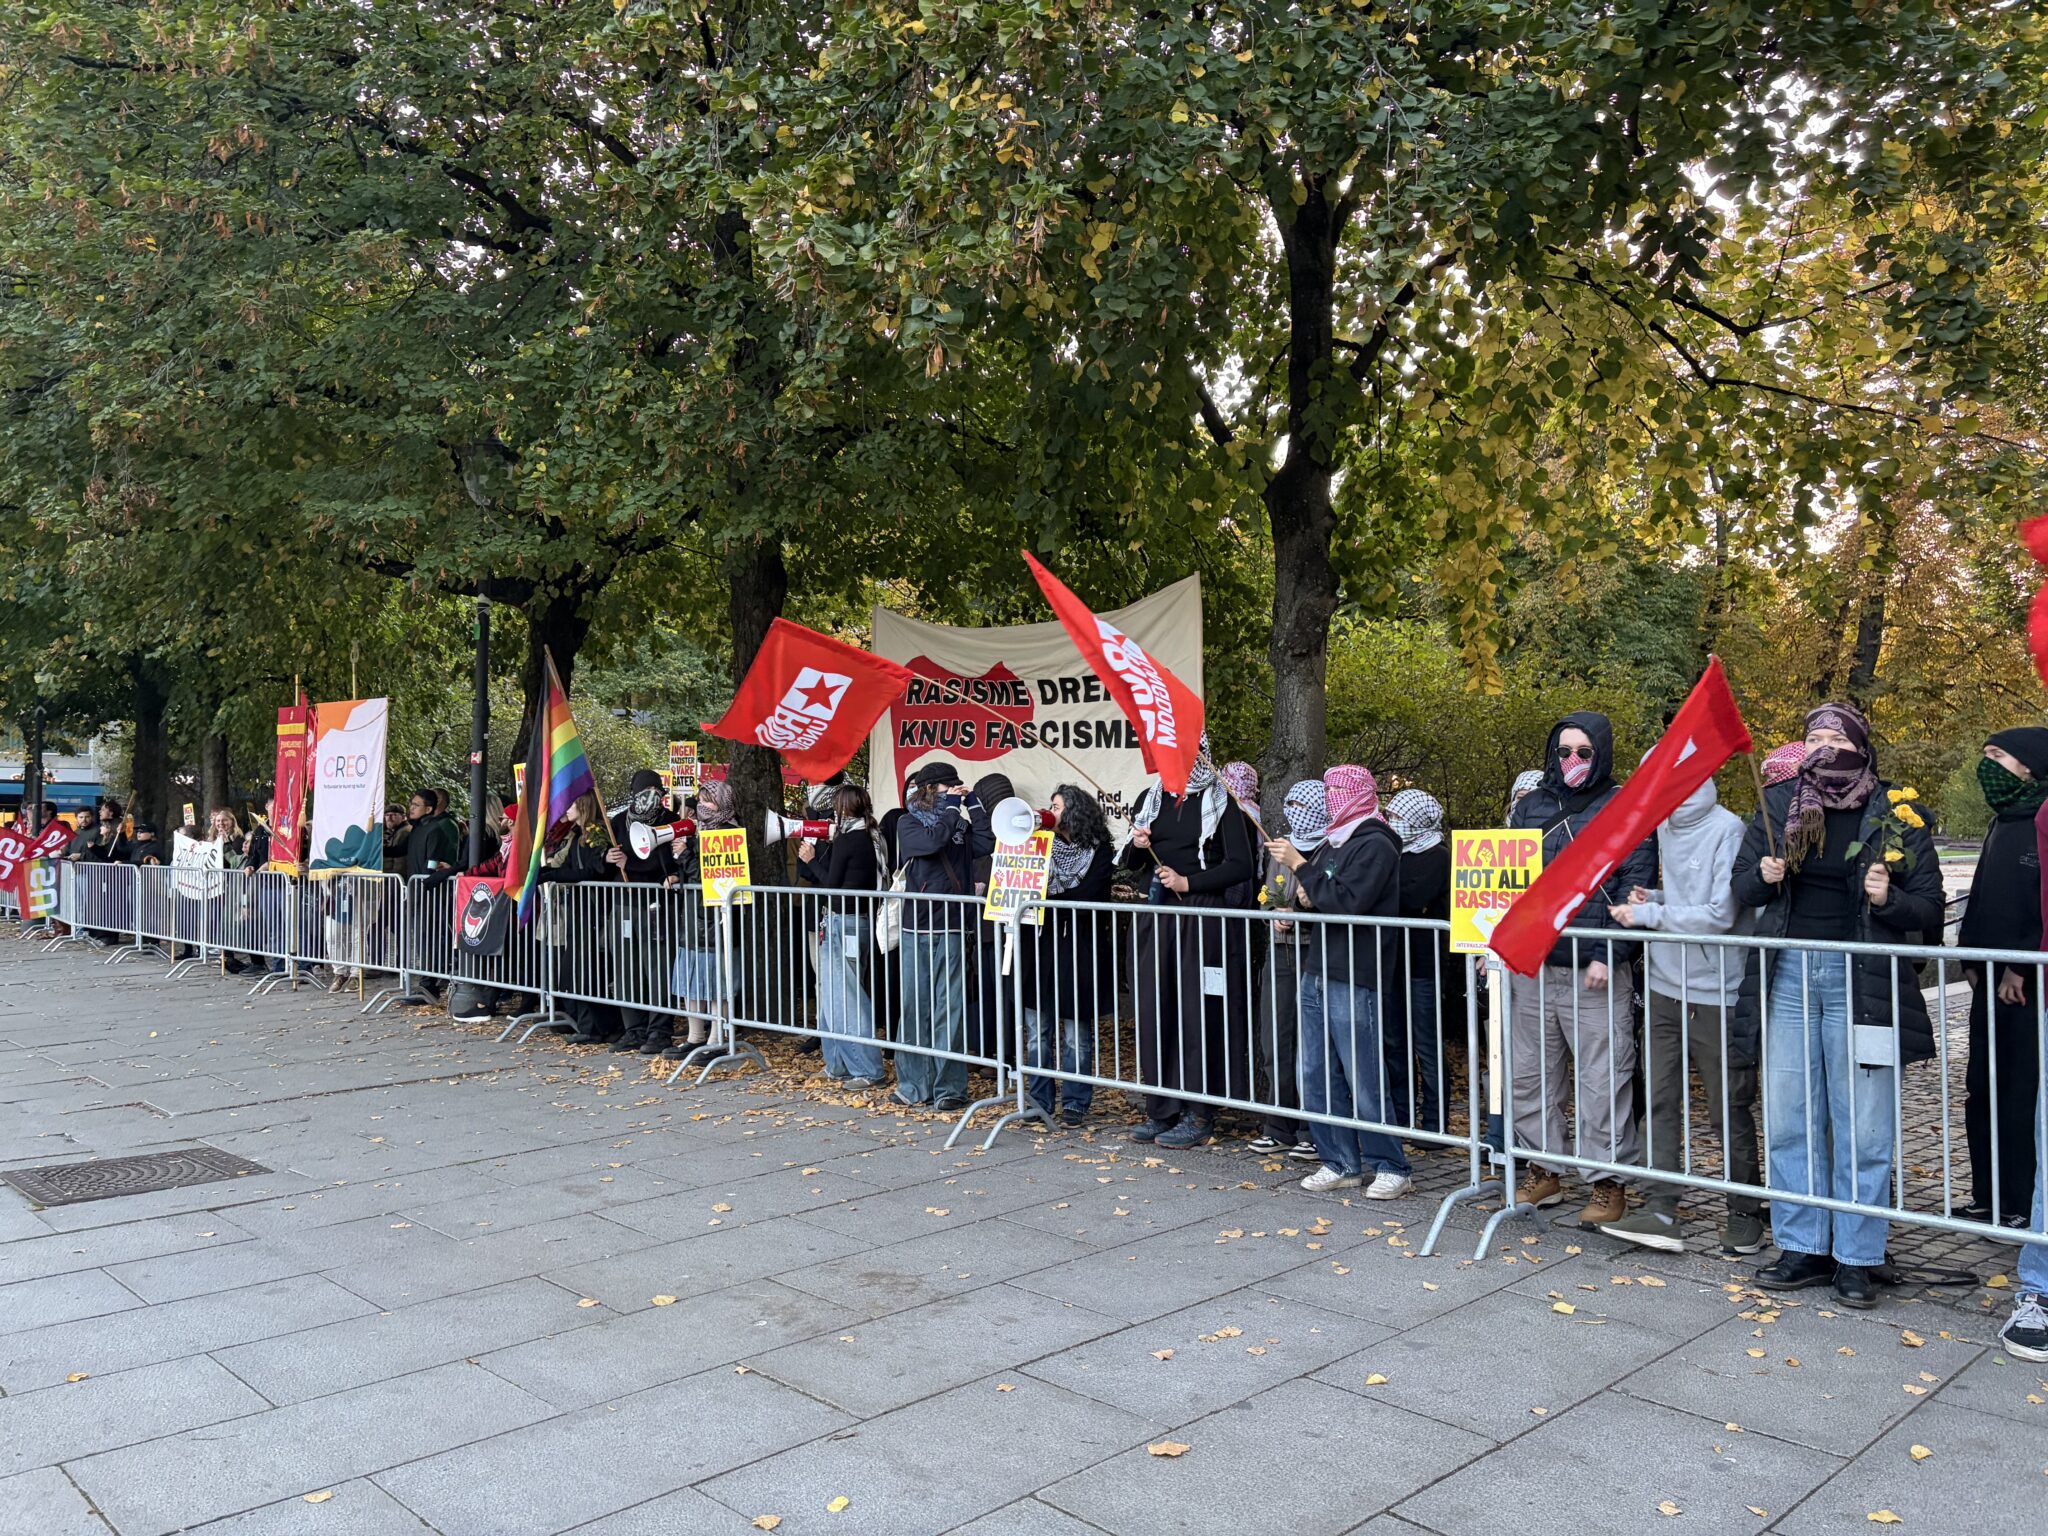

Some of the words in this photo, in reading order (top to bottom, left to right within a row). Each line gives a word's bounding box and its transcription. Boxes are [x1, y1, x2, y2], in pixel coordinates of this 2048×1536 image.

[905, 677, 1031, 707] RASISME
[1037, 675, 1112, 705] DRE
[898, 719, 977, 748] KNUS
[984, 719, 1142, 749] FASCISME
[671, 745, 695, 757] INGEN
[323, 754, 368, 778] CREO
[672, 776, 695, 787] GATER
[702, 834, 744, 854] KAMP
[1456, 838, 1539, 867] KAMP
[703, 854, 722, 867] MOT
[725, 853, 745, 866] ALL
[995, 855, 1046, 870] NAZISTER
[703, 866, 746, 879] RASISME
[1005, 869, 1045, 889] VÅRE
[1455, 869, 1495, 888] MOT
[1498, 869, 1531, 889] ALL
[1455, 889, 1528, 909] RASIS
